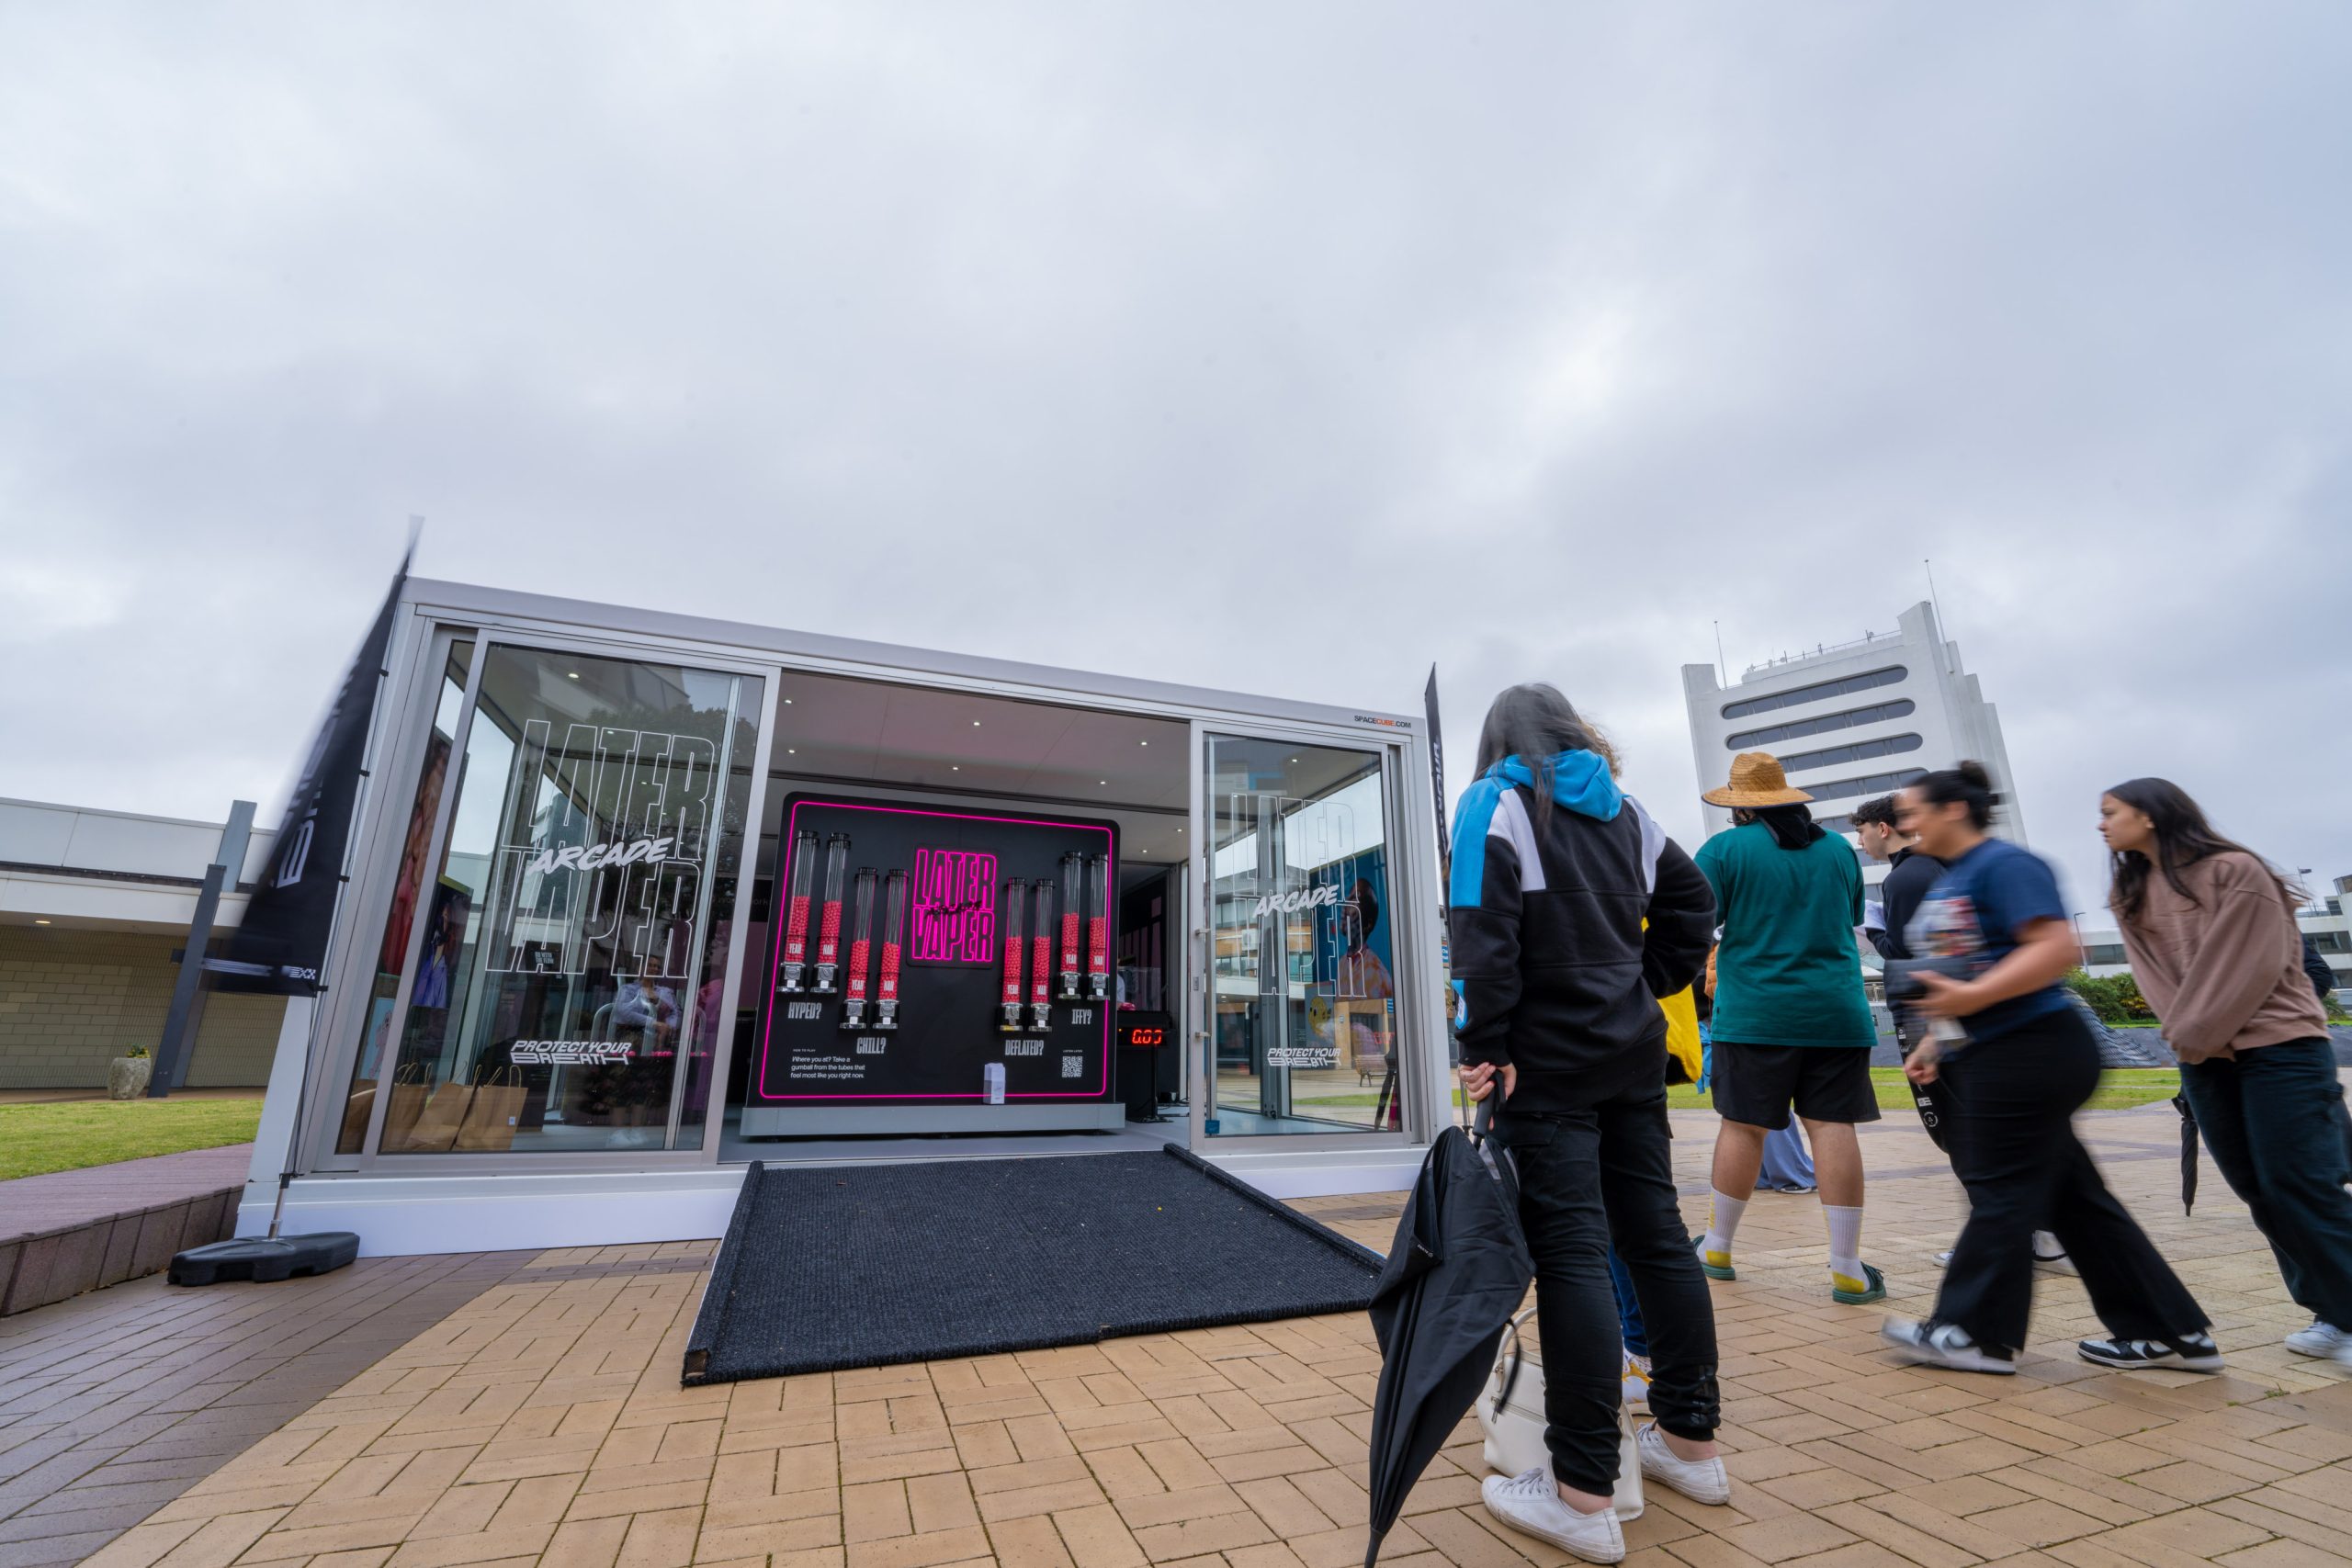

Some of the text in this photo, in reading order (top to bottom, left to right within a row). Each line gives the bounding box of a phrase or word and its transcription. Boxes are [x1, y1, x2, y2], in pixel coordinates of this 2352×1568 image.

[1353, 716, 1412, 728] SPACECUBE.COM
[502, 719, 716, 862] LATER
[527, 837, 674, 875] ARCADE
[1232, 793, 1360, 903] LATER
[913, 849, 997, 910] LATER
[1252, 885, 1340, 919] ARCADE
[485, 850, 701, 978] VAPER
[911, 906, 995, 962] VAPER
[788, 1001, 822, 1020] HYPED?
[1071, 1009, 1092, 1025] IFFY?
[511, 1040, 632, 1054] PROTECT YOUR
[856, 1037, 887, 1055] CHILL?
[1004, 1039, 1045, 1056] DEFLATED?
[1267, 1047, 1340, 1057] PROTECT YOUR
[510, 1052, 629, 1066] BREATH
[1267, 1057, 1342, 1066] BREATH
